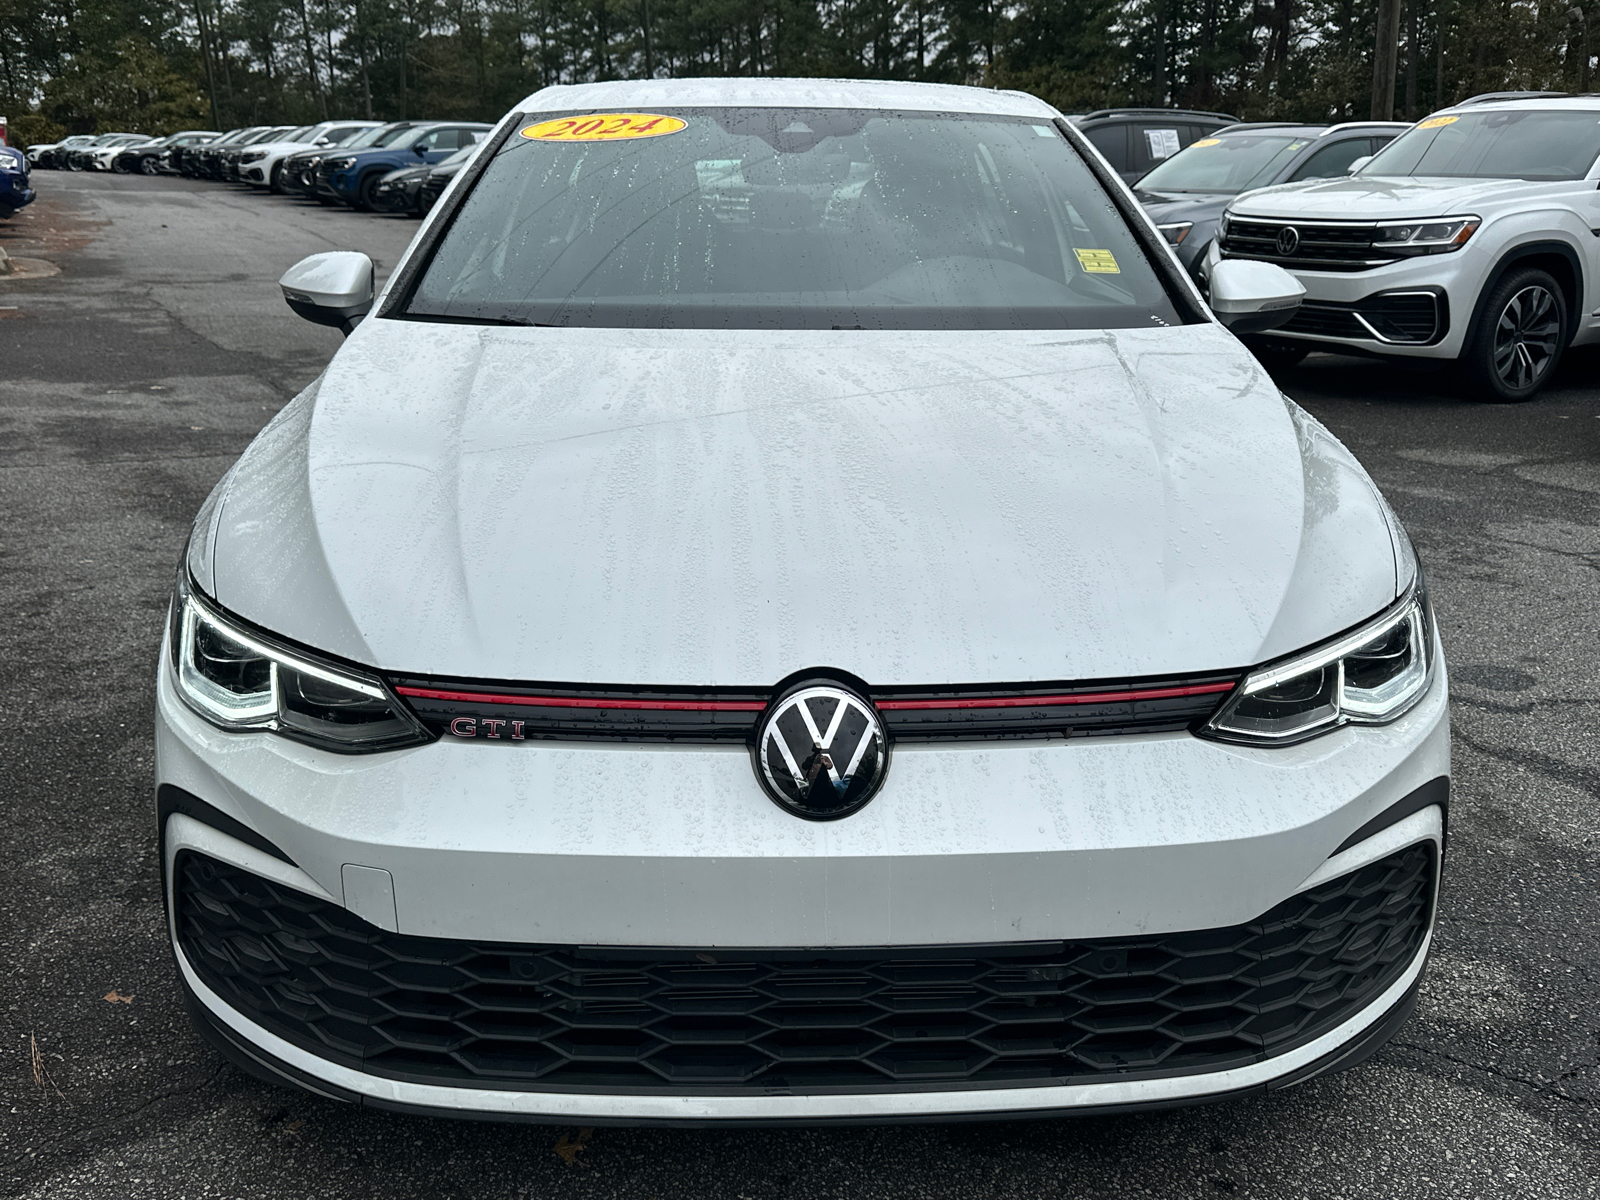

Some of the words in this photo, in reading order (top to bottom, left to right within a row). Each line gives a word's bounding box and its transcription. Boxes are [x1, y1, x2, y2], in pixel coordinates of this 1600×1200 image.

[541, 117, 664, 138] 2024
[450, 717, 525, 740] GTI
[761, 686, 885, 815] VW
